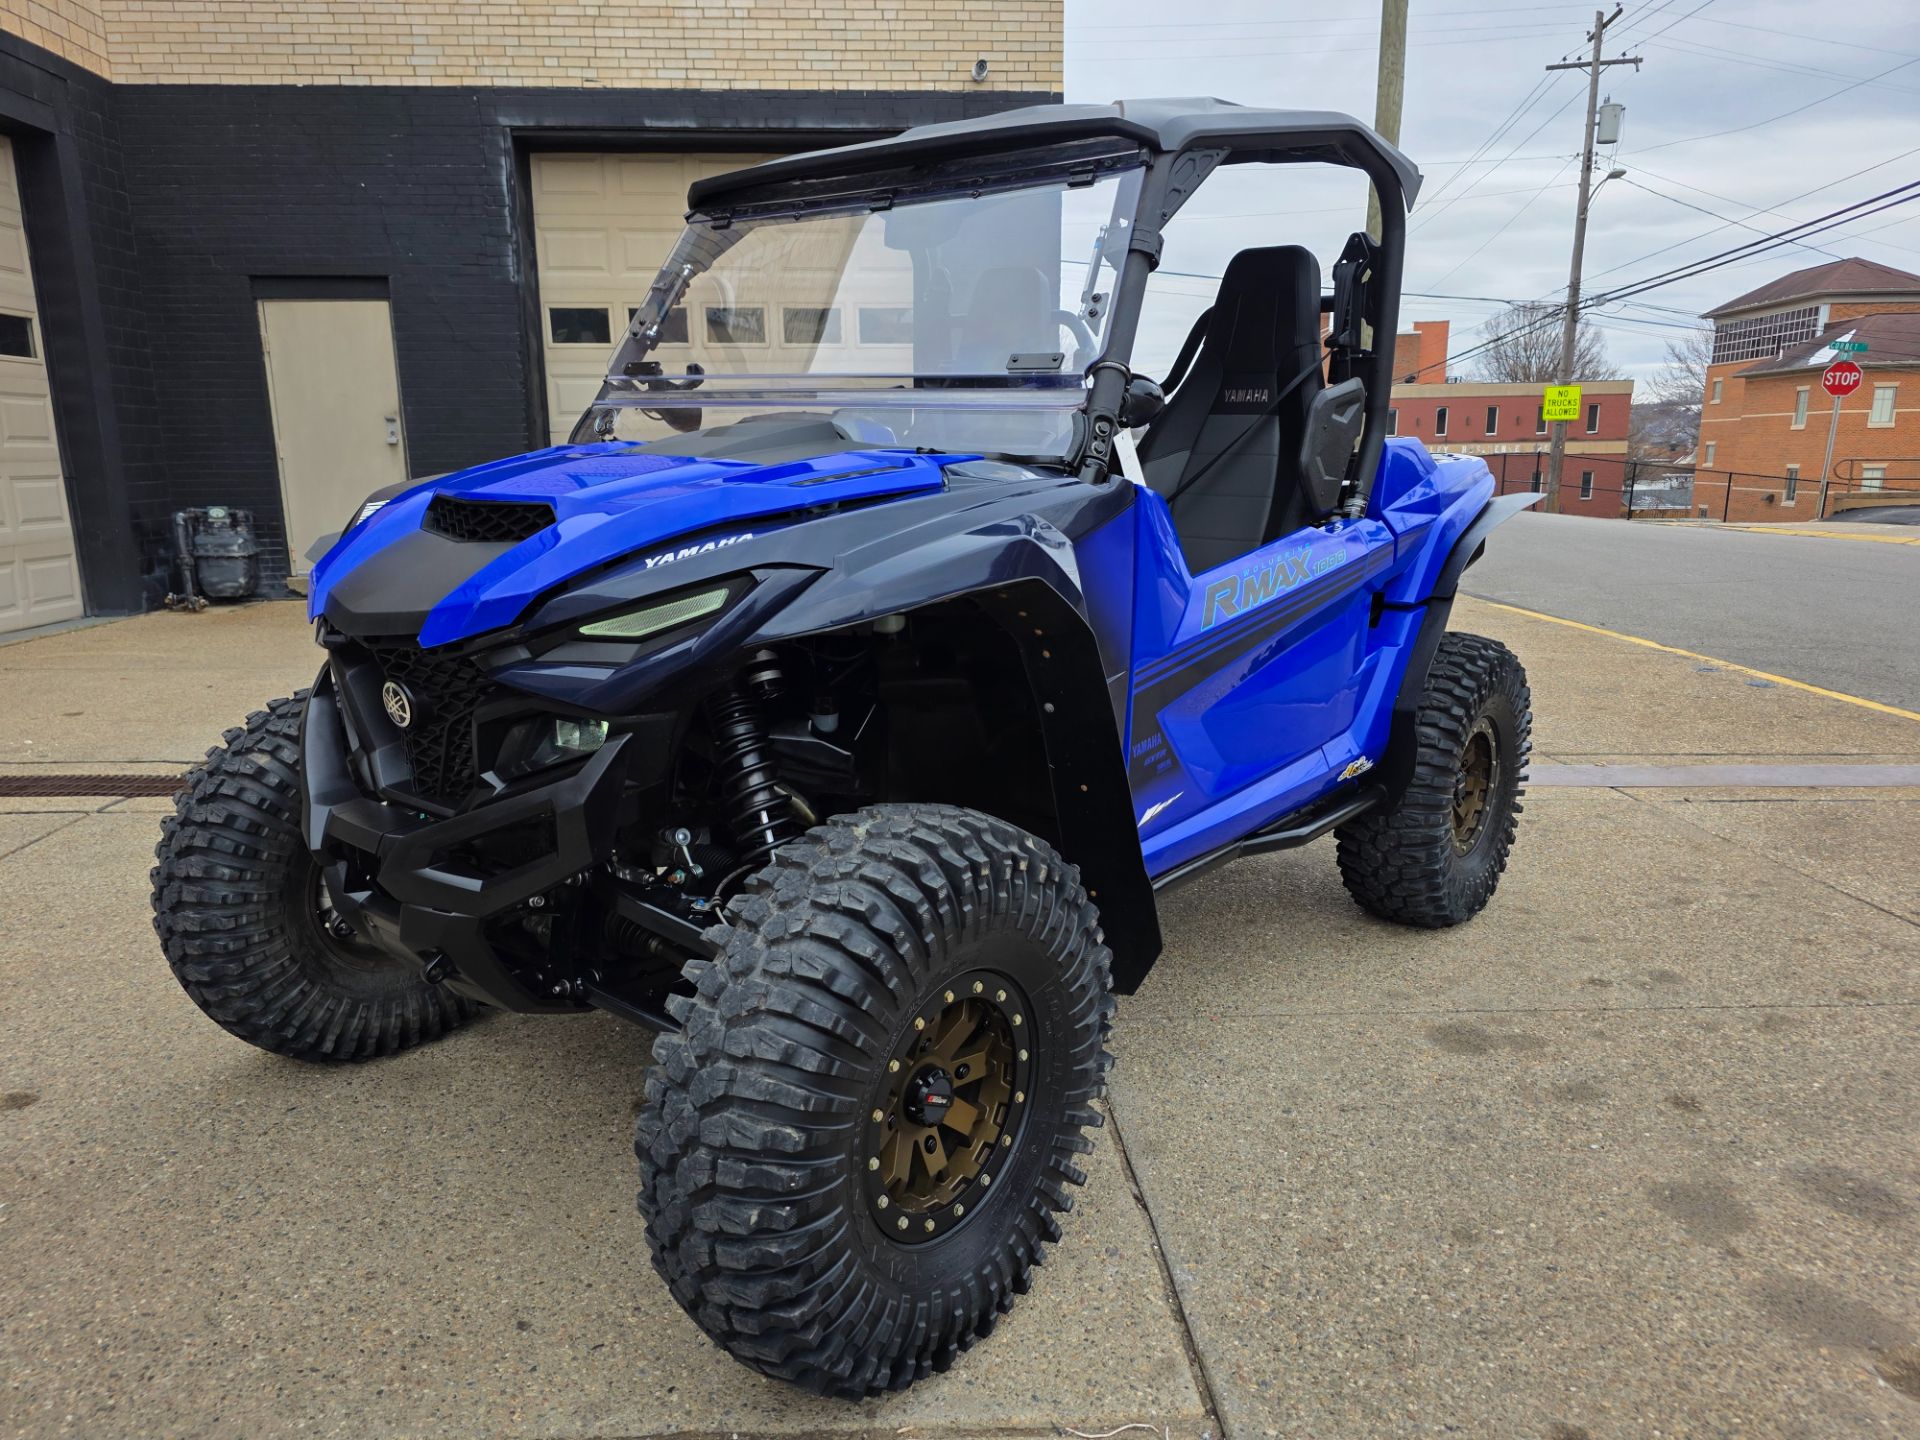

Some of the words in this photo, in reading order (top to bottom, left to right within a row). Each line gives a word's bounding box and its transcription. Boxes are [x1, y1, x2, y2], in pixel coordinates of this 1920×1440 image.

[1825, 371, 1860, 386] STOP
[1224, 388, 1269, 402] YAMAHA
[1557, 389, 1569, 398] NO
[1547, 398, 1578, 407] TRUCKS
[1545, 407, 1578, 416] ALLOWED
[644, 533, 753, 569] YAMAHA
[1132, 731, 1162, 758] YAMAHA
